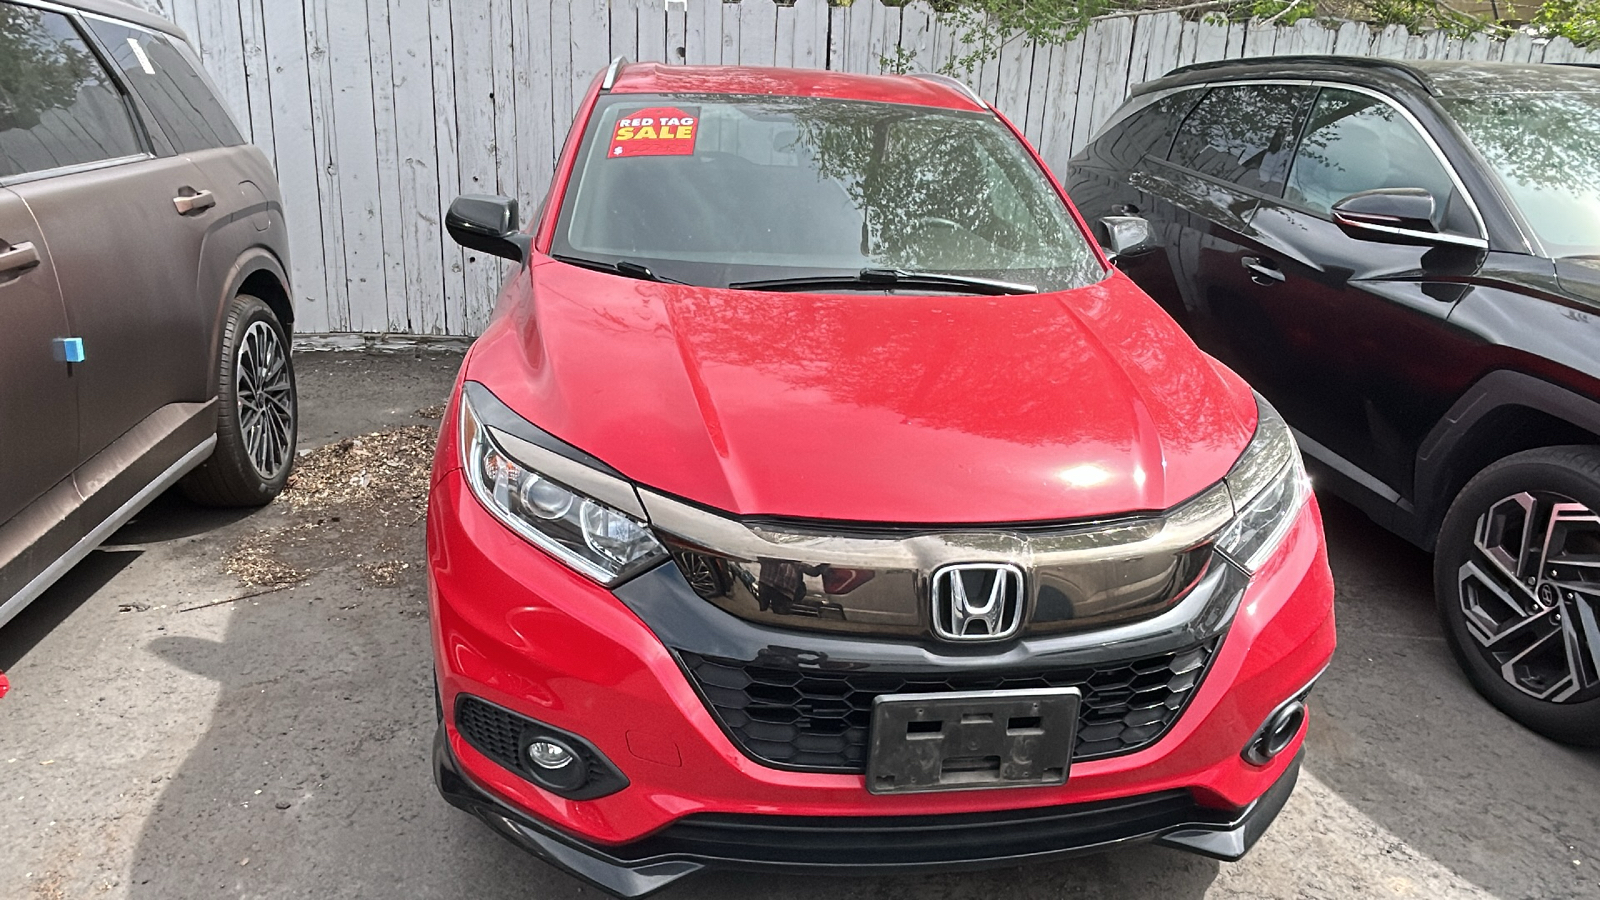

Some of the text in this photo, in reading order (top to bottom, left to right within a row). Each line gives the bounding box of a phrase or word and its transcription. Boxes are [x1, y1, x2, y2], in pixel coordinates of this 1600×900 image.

[620, 118, 694, 127] RED TAG
[616, 126, 693, 140] SALE
